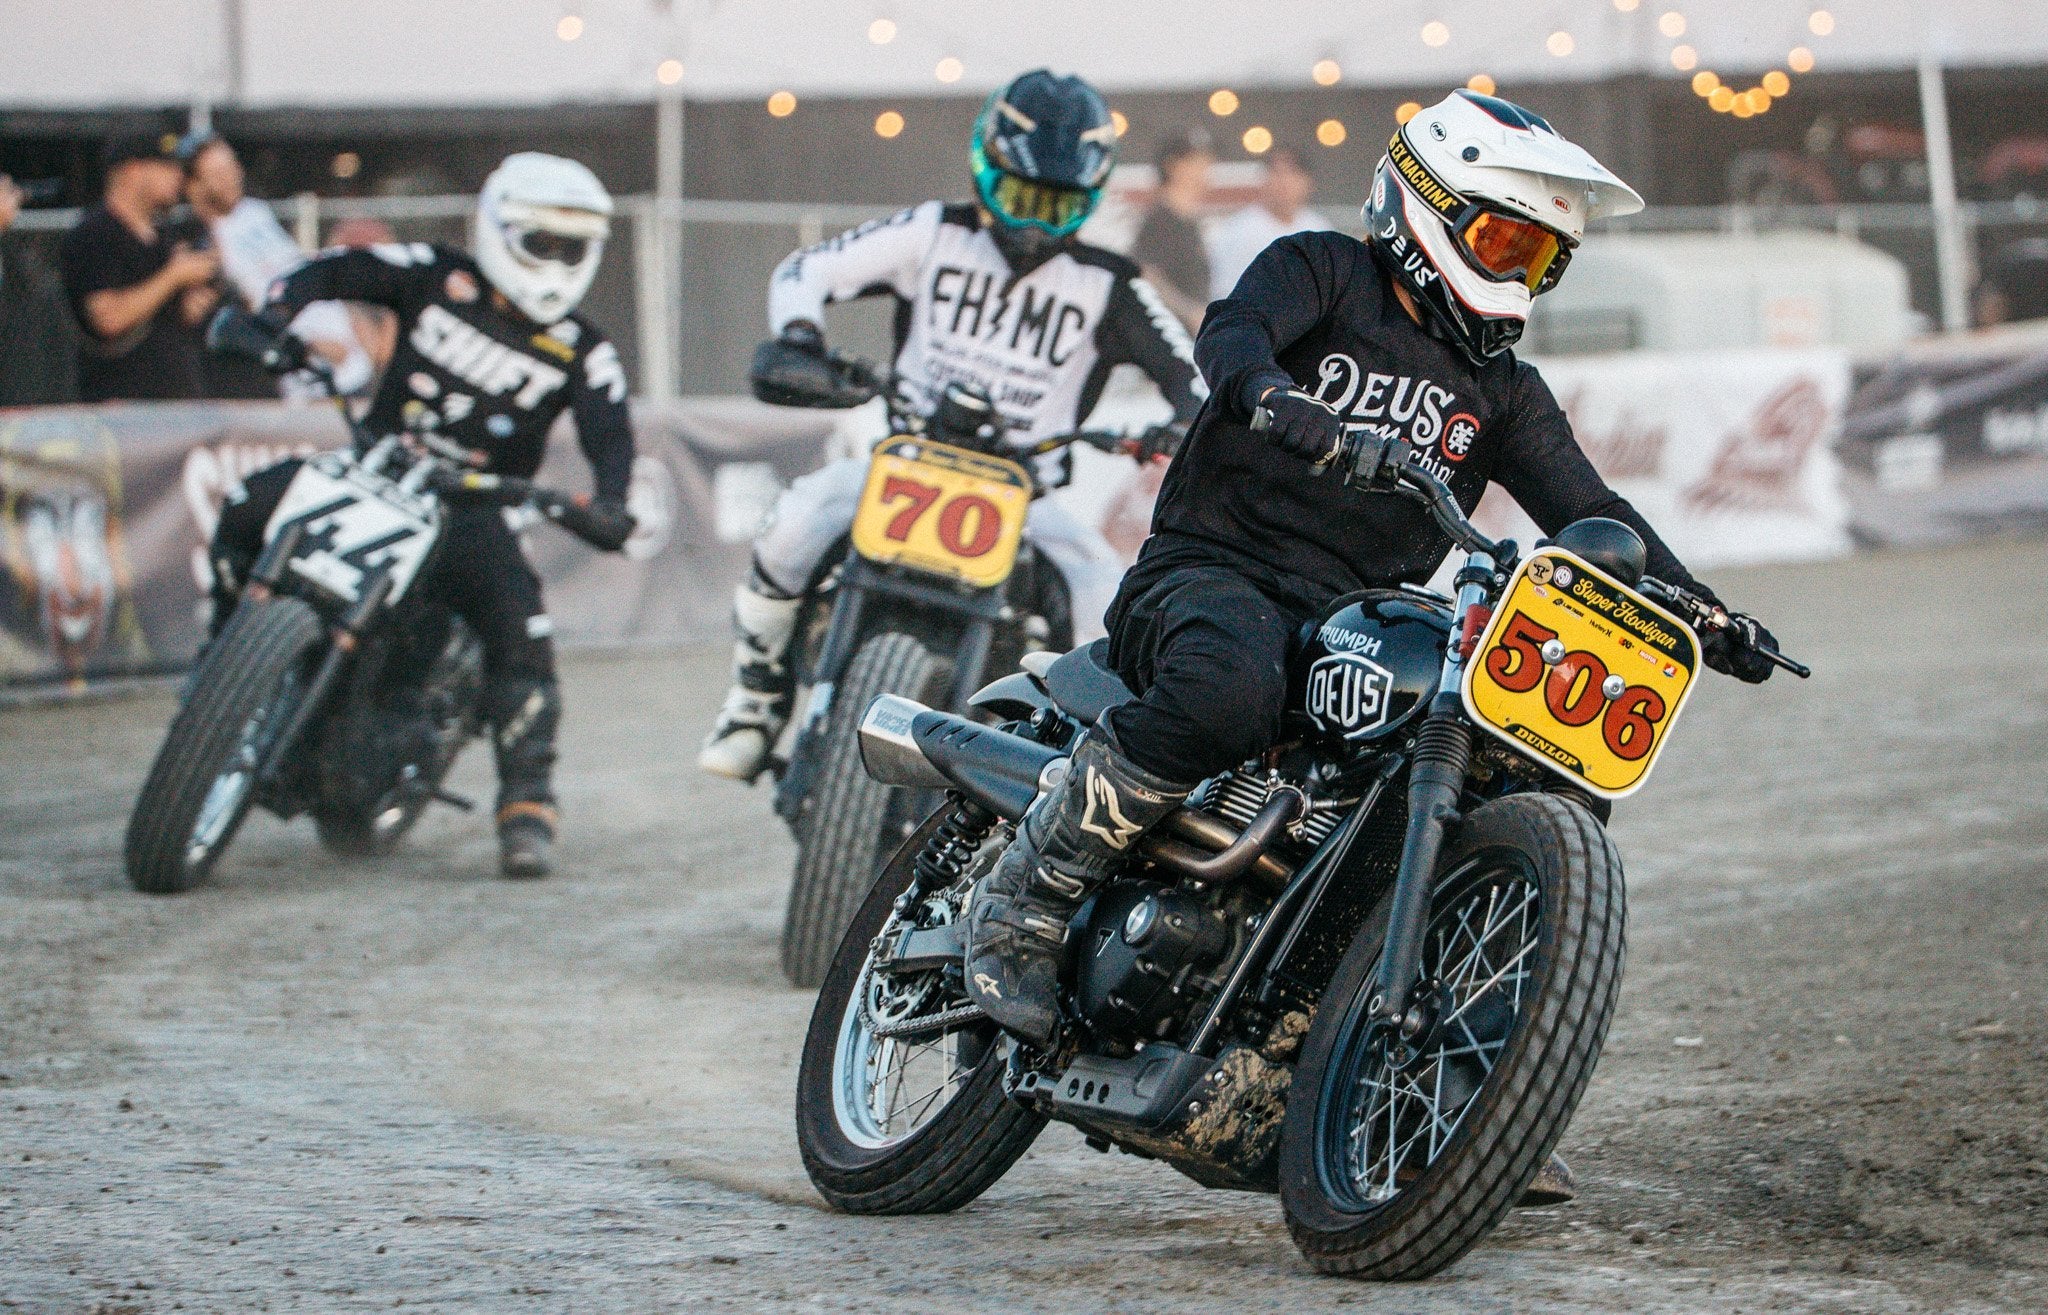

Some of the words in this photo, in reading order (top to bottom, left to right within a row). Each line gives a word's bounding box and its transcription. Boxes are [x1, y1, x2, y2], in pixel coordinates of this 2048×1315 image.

[1391, 143, 1407, 163] EX
[1398, 155, 1454, 211] MACHINA
[1555, 198, 1569, 211] BELL
[1381, 216, 1439, 287] DEUS
[409, 304, 568, 410] SHIFT
[880, 475, 1002, 558] 70
[1316, 625, 1382, 657] TRIUMPH
[1573, 578, 1617, 611] Super
[1613, 601, 1677, 650] Hooligan
[1311, 663, 1380, 728] DEUS
[1485, 608, 1666, 761] 506
[1513, 725, 1578, 768] DUNLOP
